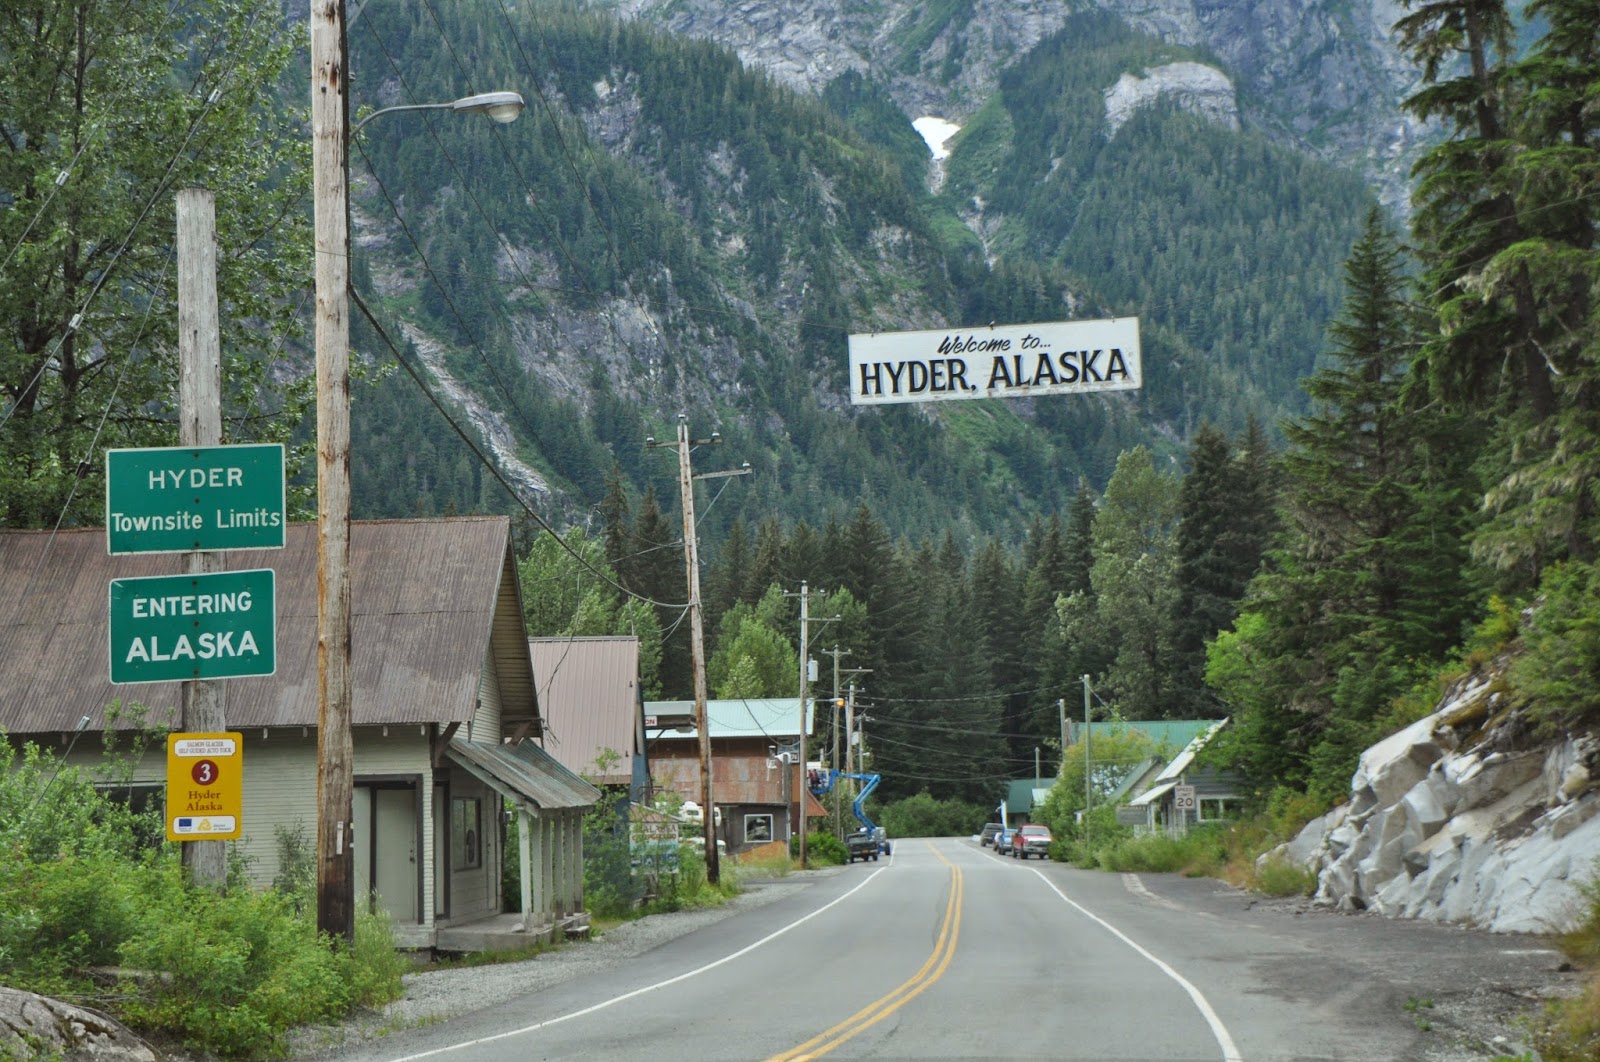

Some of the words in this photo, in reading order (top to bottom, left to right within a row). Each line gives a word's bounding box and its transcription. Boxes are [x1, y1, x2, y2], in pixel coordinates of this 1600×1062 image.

[936, 335, 1011, 355] Welcome
[1021, 333, 1051, 350] to...
[859, 358, 977, 396] HYDER,
[986, 348, 1131, 391] ALASKA
[149, 467, 243, 490] HYDER
[111, 510, 203, 532] Townsite
[216, 507, 281, 529] Limits
[132, 591, 252, 618] ENTERING
[125, 630, 260, 663] ALASKA
[199, 763, 211, 782] 3
[186, 801, 223, 811] Alaska
[188, 790, 221, 802] Hyder
[1177, 797, 1193, 807] 20
